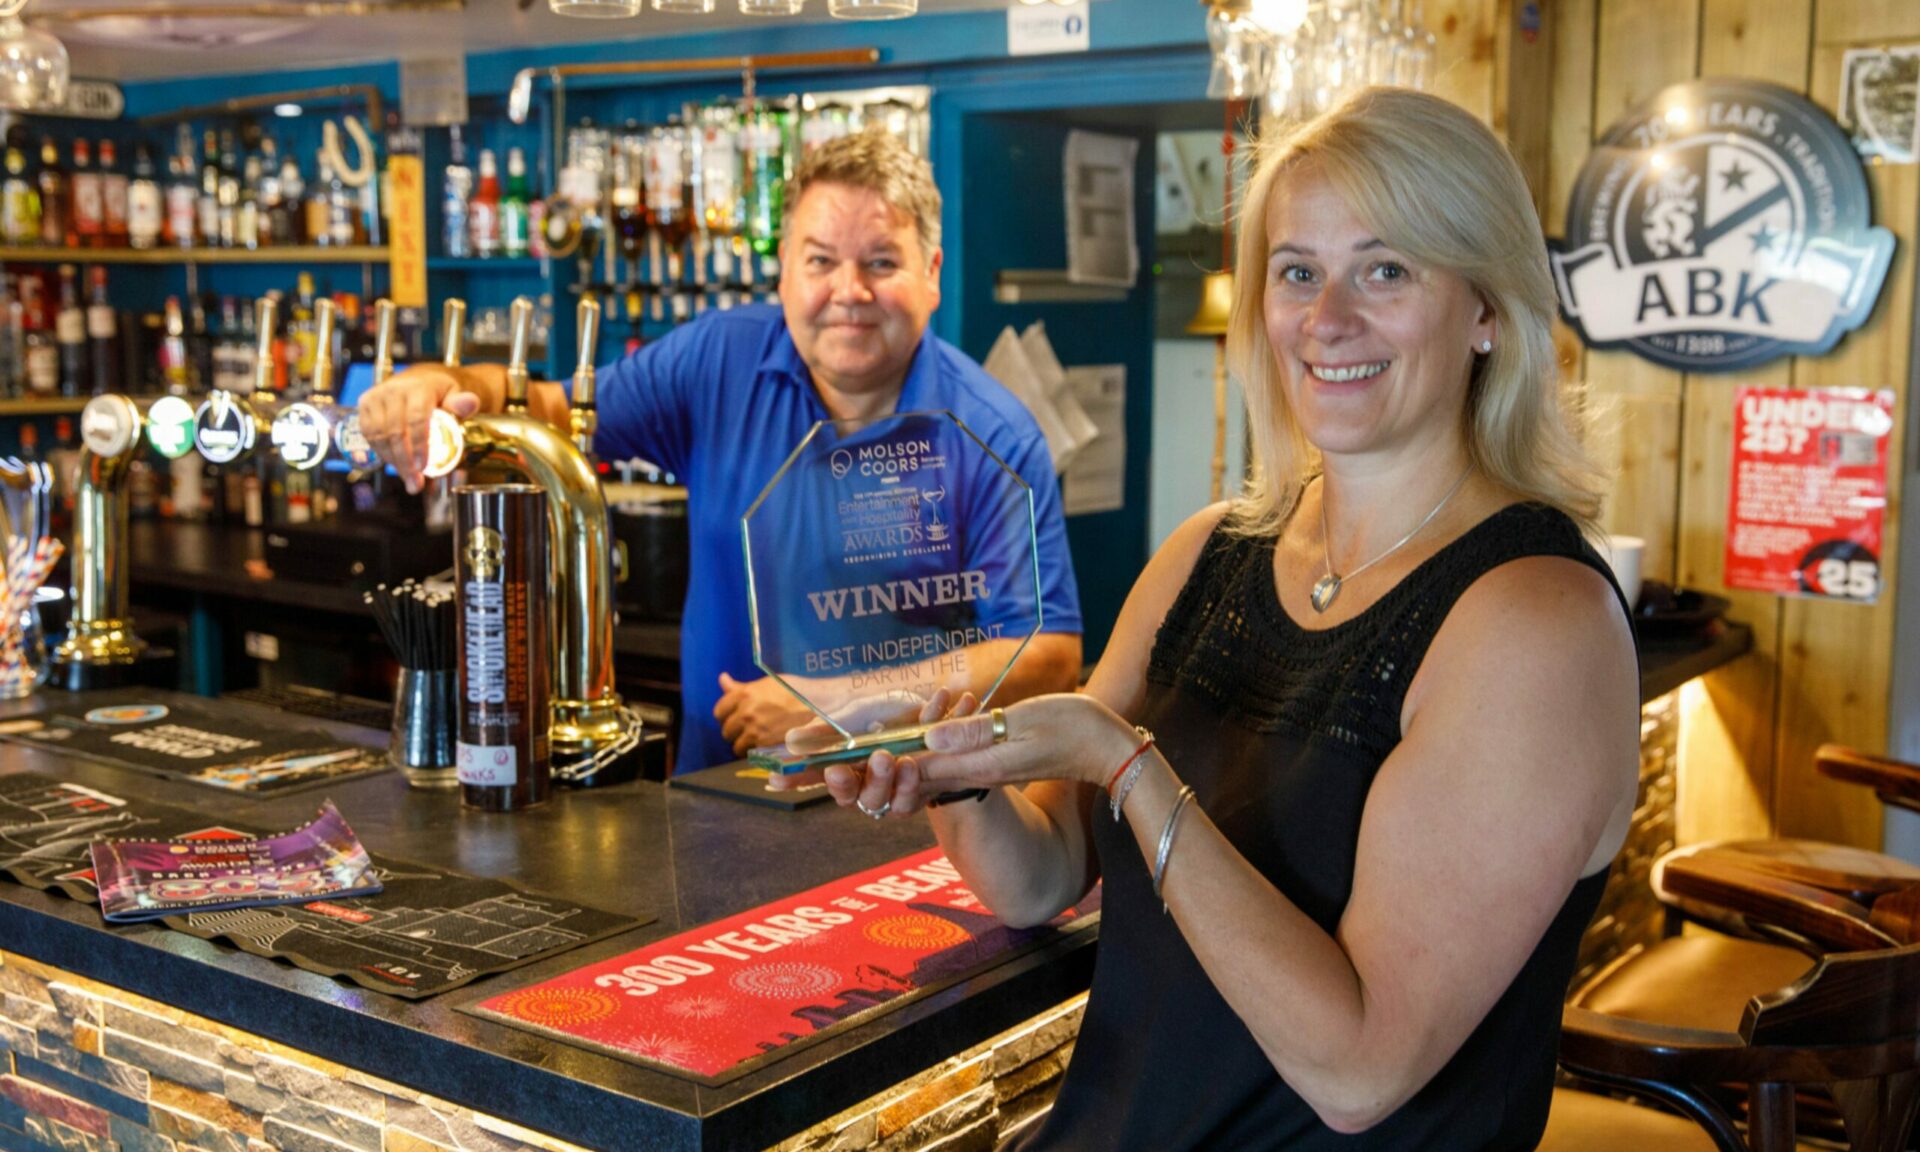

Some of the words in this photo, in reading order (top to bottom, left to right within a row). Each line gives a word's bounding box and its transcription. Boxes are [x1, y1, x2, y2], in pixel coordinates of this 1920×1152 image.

[1634, 268, 1784, 327] ABK
[859, 440, 931, 461] MOLSON
[1740, 425, 1810, 454] 25?
[860, 457, 919, 477] COORS
[838, 495, 920, 515] Entertainment
[861, 508, 921, 526] Hospitality
[844, 525, 924, 552] AWARDS
[902, 543, 952, 557] EXCELLENCE
[1817, 558, 1878, 598] 25
[806, 569, 991, 622] WINNER
[465, 581, 506, 704] SMOKEHEAD
[805, 645, 855, 673] BEST
[862, 623, 1005, 664] INDEPENDENT
[851, 667, 893, 690] BAR
[899, 662, 921, 682] IN
[925, 653, 967, 676] THE
[594, 954, 715, 997] 300
[684, 905, 854, 961] YEARS
